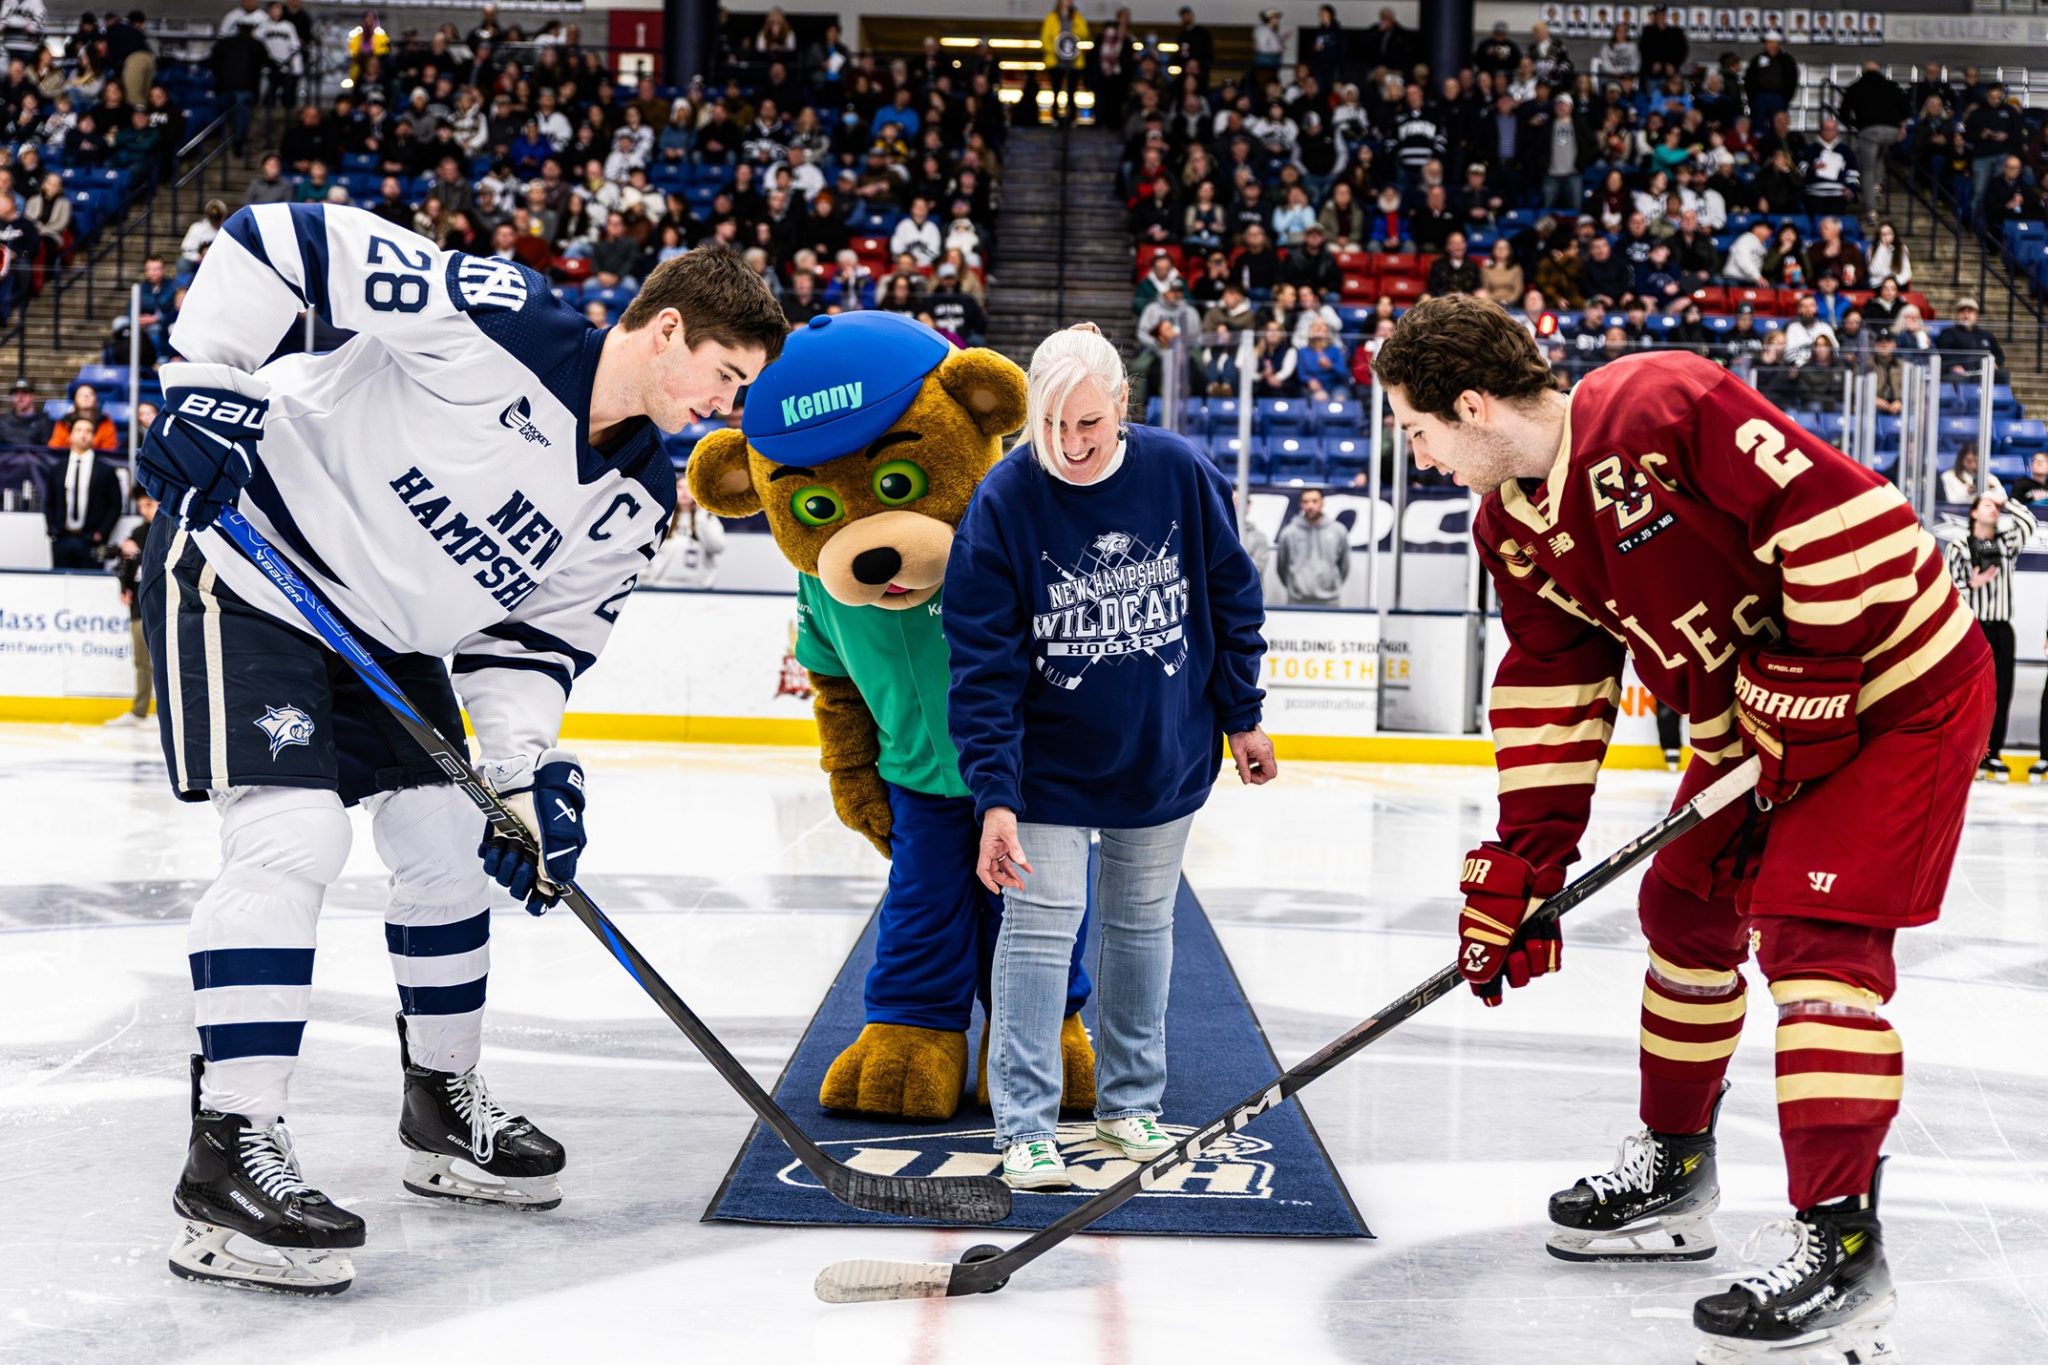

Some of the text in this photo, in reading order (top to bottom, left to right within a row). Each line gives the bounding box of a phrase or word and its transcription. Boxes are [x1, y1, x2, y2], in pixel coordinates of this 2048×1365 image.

[365, 235, 431, 313] 28
[781, 381, 863, 427] Kenny
[519, 426, 536, 442] EAST
[525, 421, 551, 447] HOCKEY
[1735, 418, 1814, 489] 2
[588, 493, 641, 541] C
[389, 466, 540, 613] HAMPSH
[1047, 553, 1180, 609] NEW HAMPSHIRE
[0, 608, 46, 630] ass
[1033, 575, 1190, 641] WILDCATS
[1067, 632, 1170, 655] HOCKEY
[1269, 638, 1336, 652] BUILDING
[1268, 656, 1410, 681] TOGETHER
[1767, 664, 1804, 674] EAGLES
